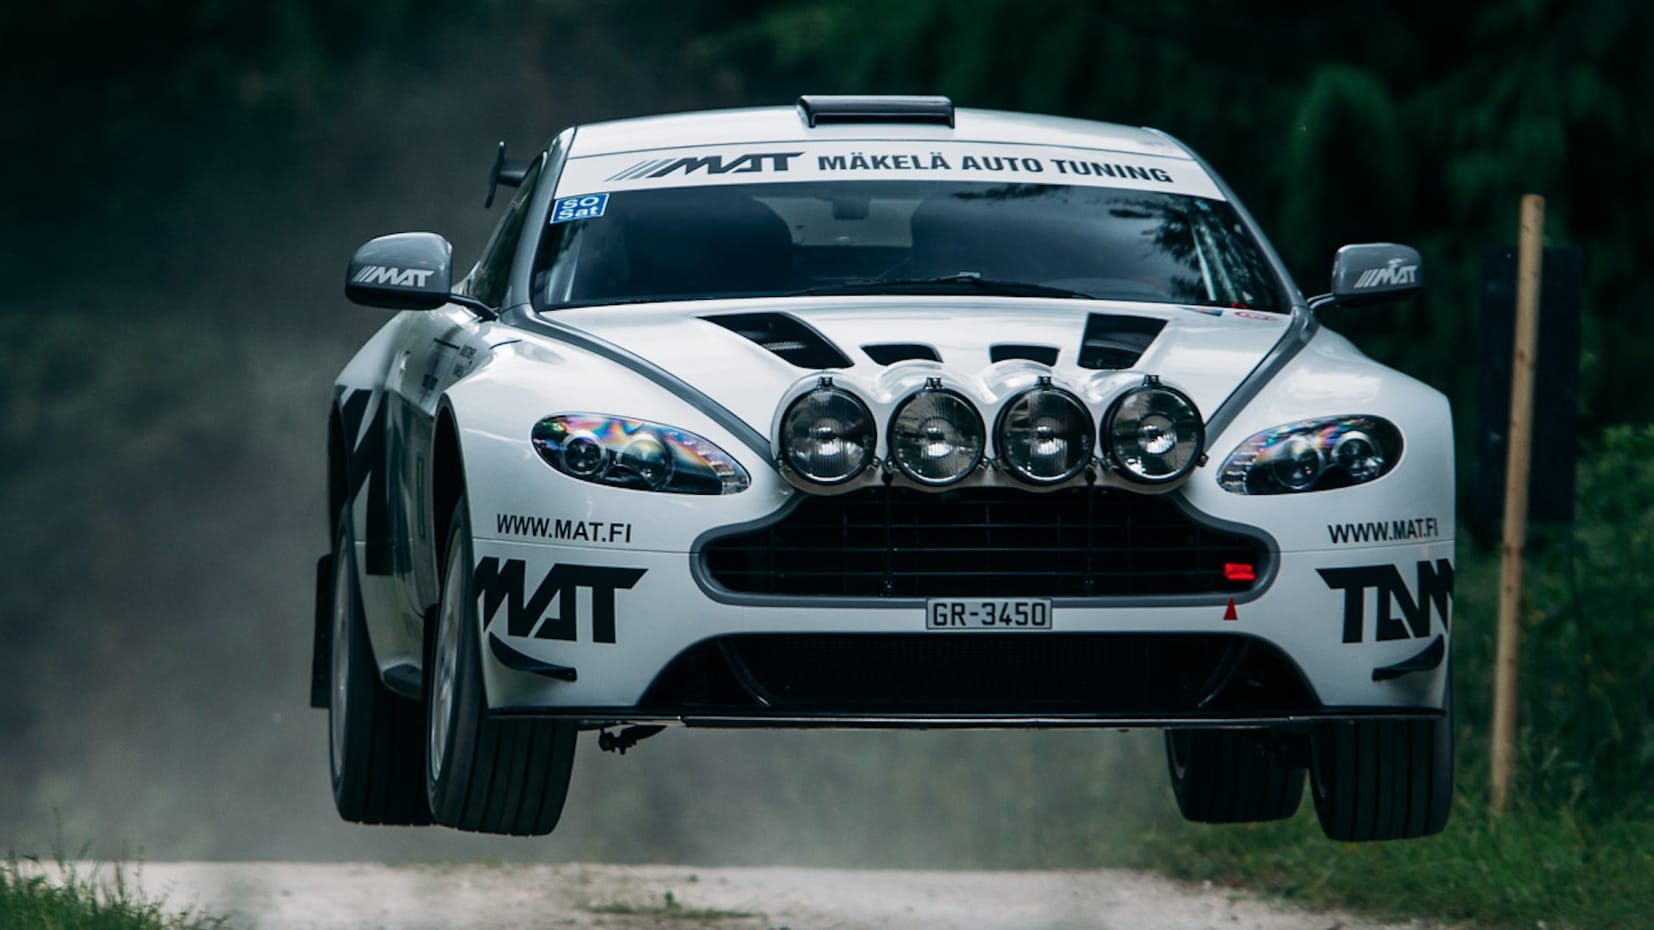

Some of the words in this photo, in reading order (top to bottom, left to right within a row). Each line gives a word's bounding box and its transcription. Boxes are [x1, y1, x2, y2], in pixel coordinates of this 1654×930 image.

[646, 152, 806, 178] MAT
[818, 152, 952, 171] MÄKELÄ
[962, 155, 1043, 173] AUTO
[1050, 159, 1174, 183] TUNING
[558, 206, 598, 220] Sat
[561, 196, 600, 209] SO
[364, 266, 435, 288] MAT
[496, 513, 632, 543] WWW.MAT.FI
[1327, 517, 1439, 544] WWW.MAT.FI
[474, 556, 649, 644] MAT
[933, 602, 1046, 626] GR-3450
